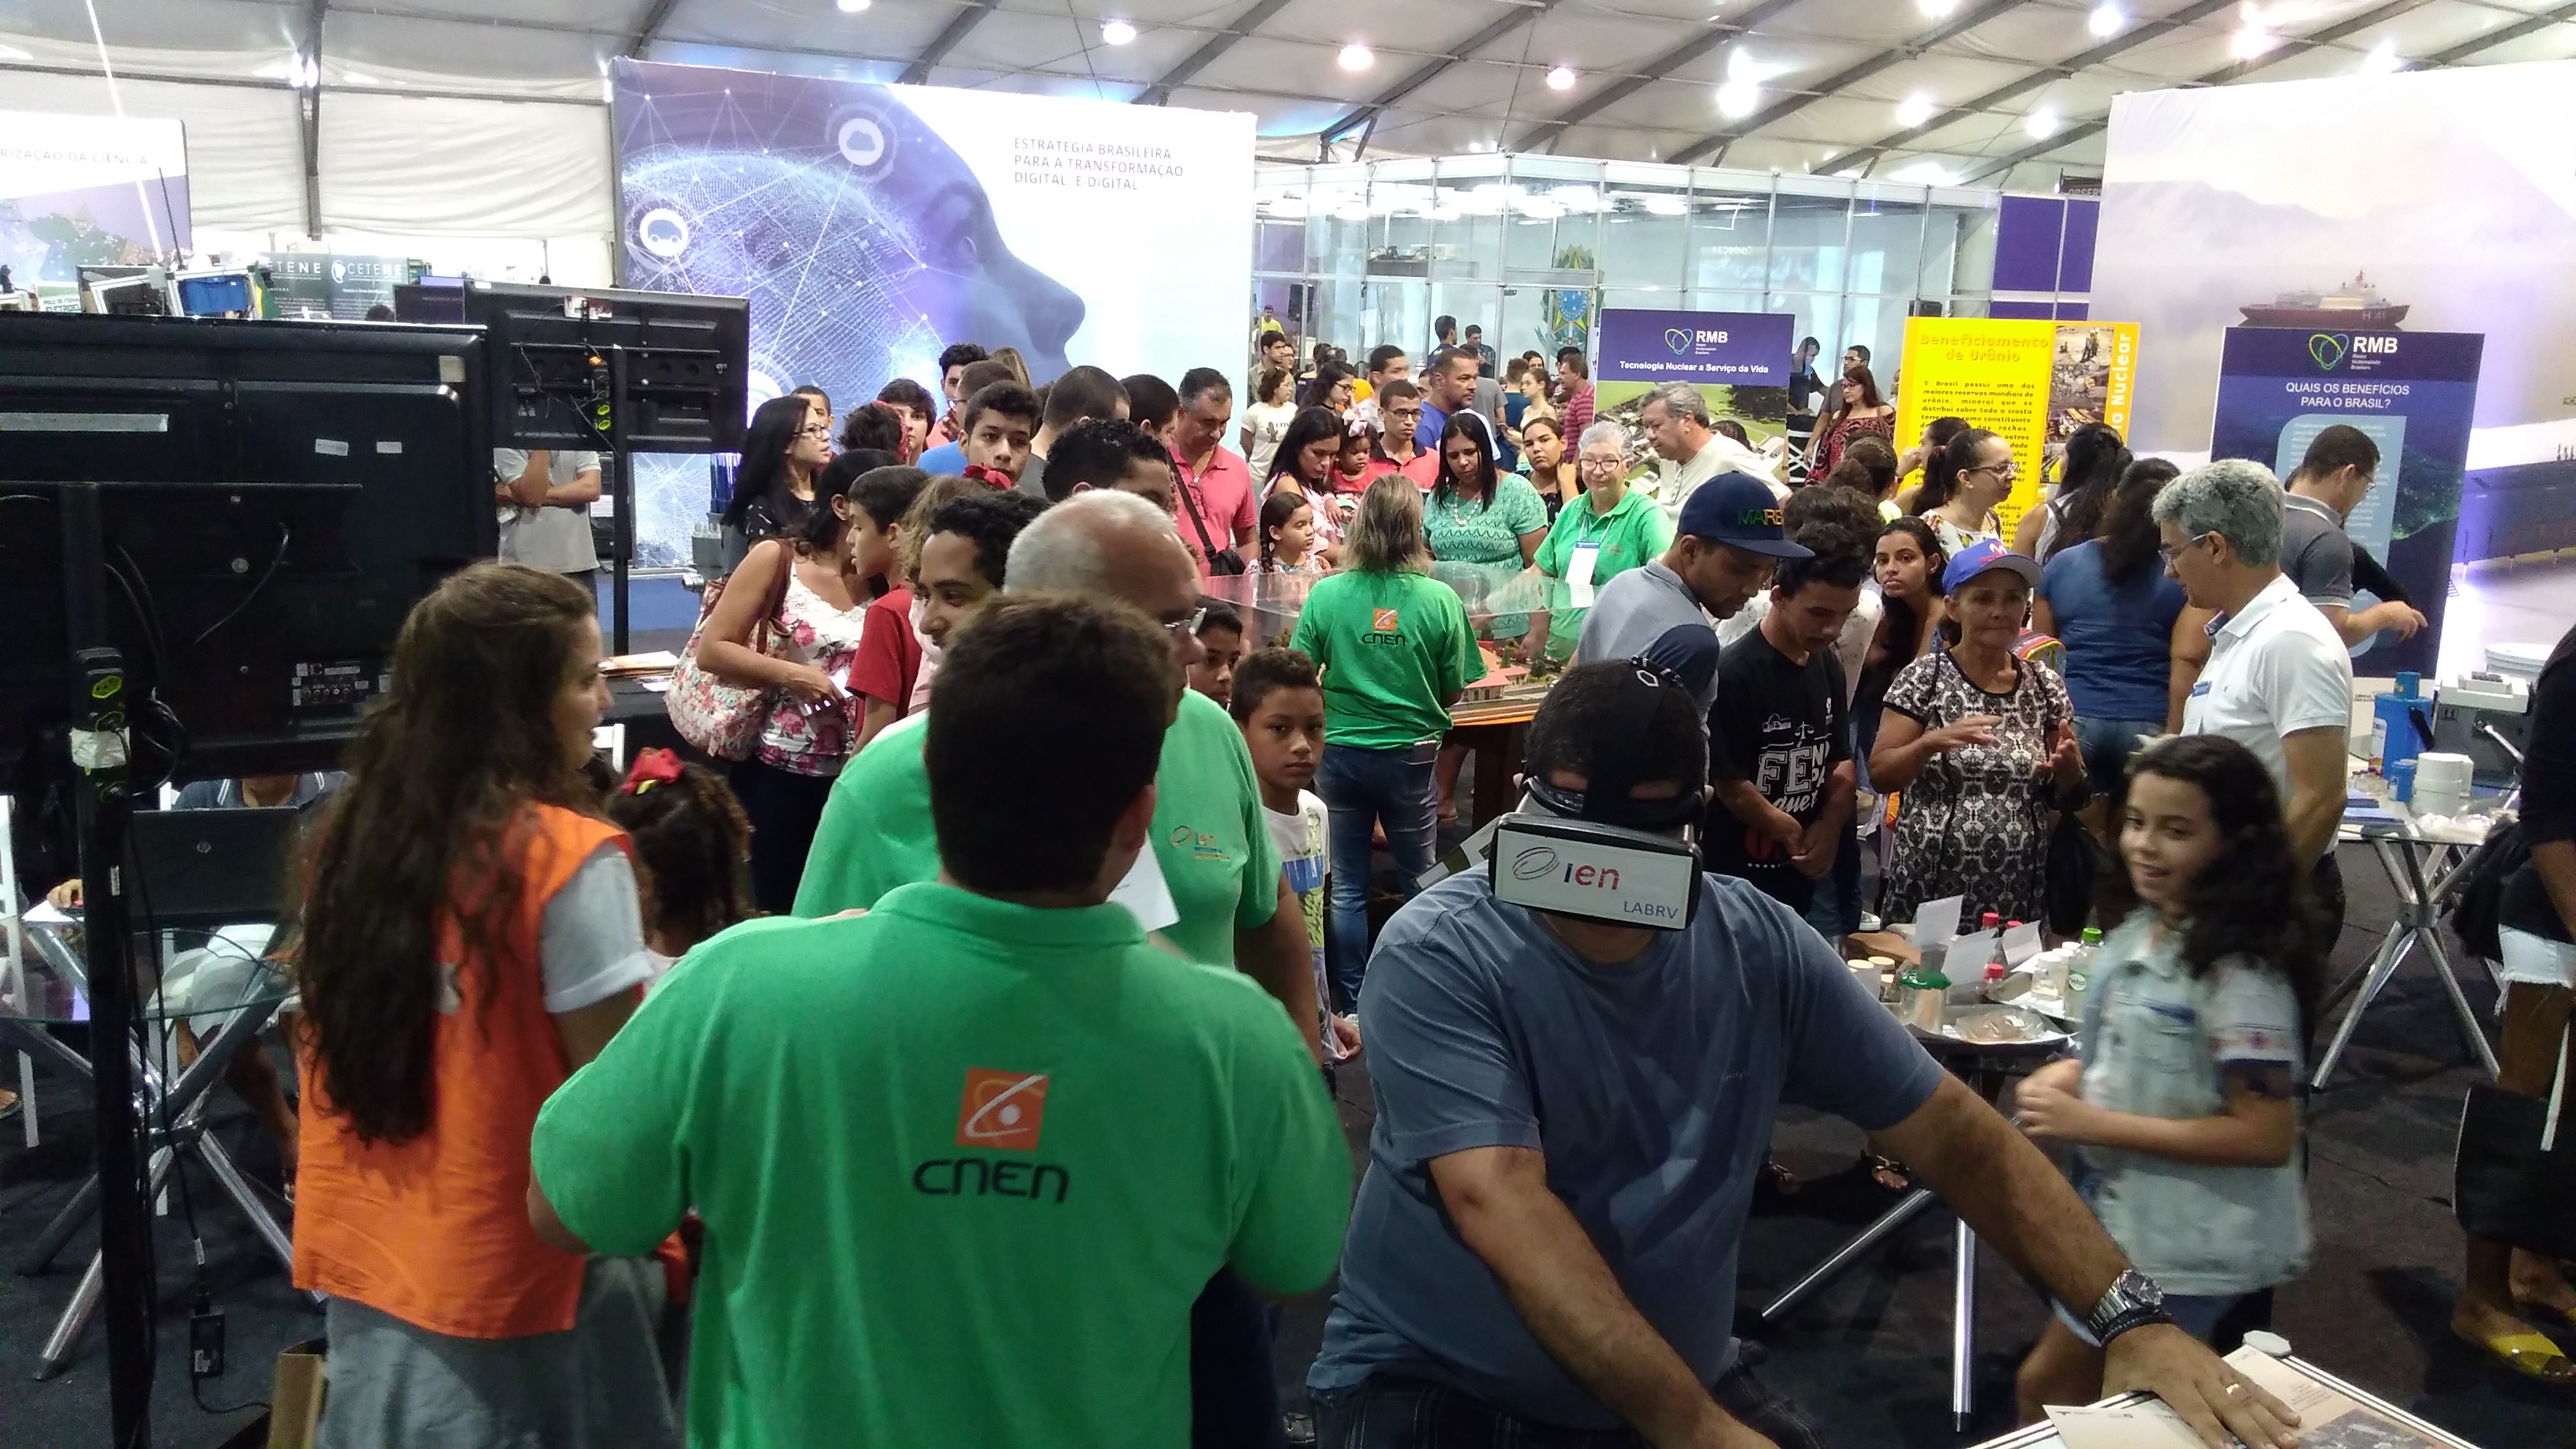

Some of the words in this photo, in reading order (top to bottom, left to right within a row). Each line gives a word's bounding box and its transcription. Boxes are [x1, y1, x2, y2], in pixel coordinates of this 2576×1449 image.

[69, 152, 87, 162] DA
[1098, 143, 1171, 159] BRASILEIRA
[1014, 155, 1050, 167] PARA
[1054, 157, 1063, 168] A
[346, 263, 402, 275] CETENE
[1696, 330, 1728, 344] RMB
[1920, 334, 2049, 348] Beneficiamento
[2353, 336, 2398, 354] RMB
[1946, 349, 1964, 361] de
[1971, 349, 2020, 362] Urânio
[1619, 361, 1664, 372] Tecnologia
[1666, 362, 1697, 371] Nuclear
[1705, 363, 1736, 373] Serviço
[1750, 365, 1769, 373] Vida
[2111, 334, 2131, 405] Nuclear
[2286, 382, 2321, 393] QUAIS
[2323, 384, 2340, 393] OS
[2342, 384, 2409, 395] BENEFÍCIOS
[2301, 396, 2331, 406] PARA
[2333, 398, 2342, 407] O
[2345, 398, 2391, 409] BRASIL?
[1623, 900, 1678, 919] LABRV
